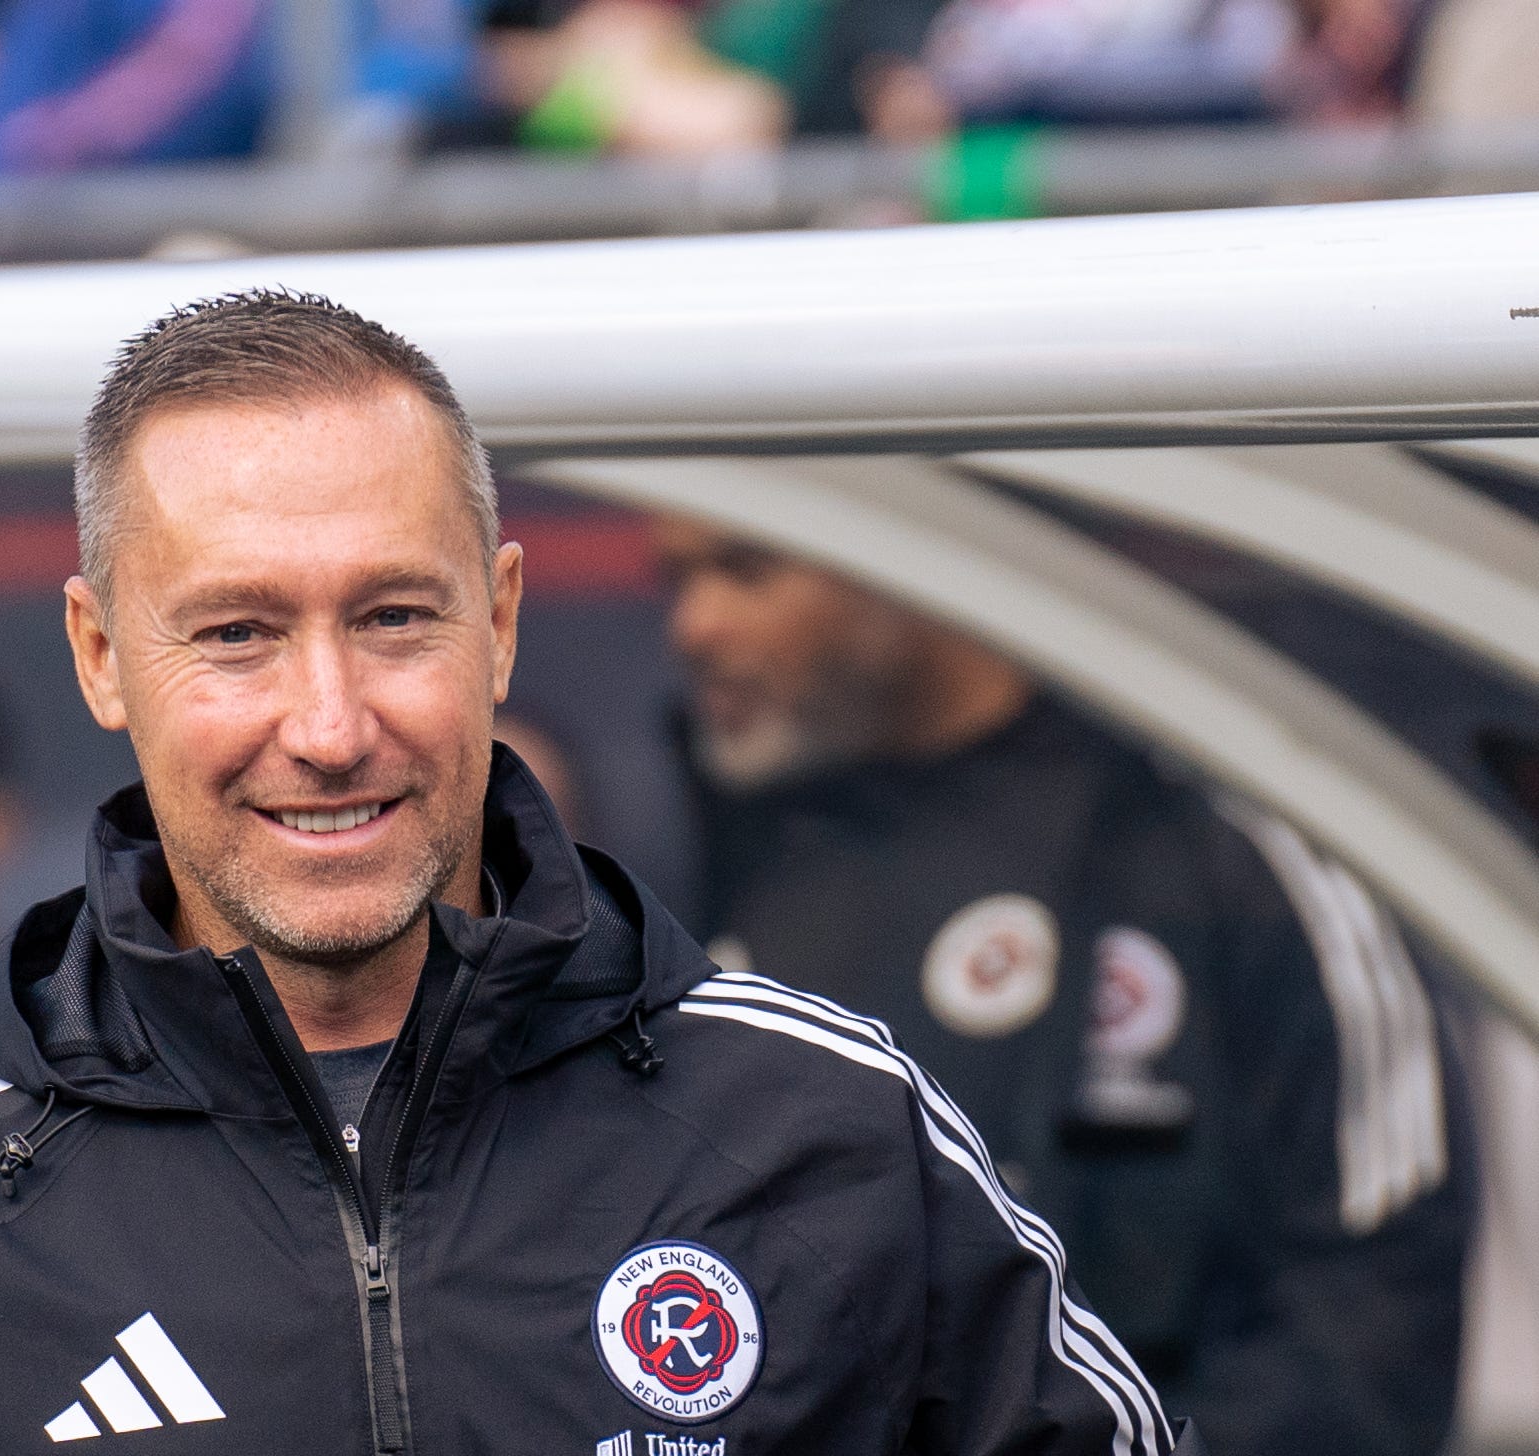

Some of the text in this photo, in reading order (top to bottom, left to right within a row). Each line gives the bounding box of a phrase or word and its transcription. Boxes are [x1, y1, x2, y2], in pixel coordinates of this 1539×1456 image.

[617, 1252, 739, 1296] NEW ENGLAND
[602, 1322, 616, 1334] 19
[743, 1332, 758, 1344] 96
[633, 1380, 733, 1415] REVOLUTION
